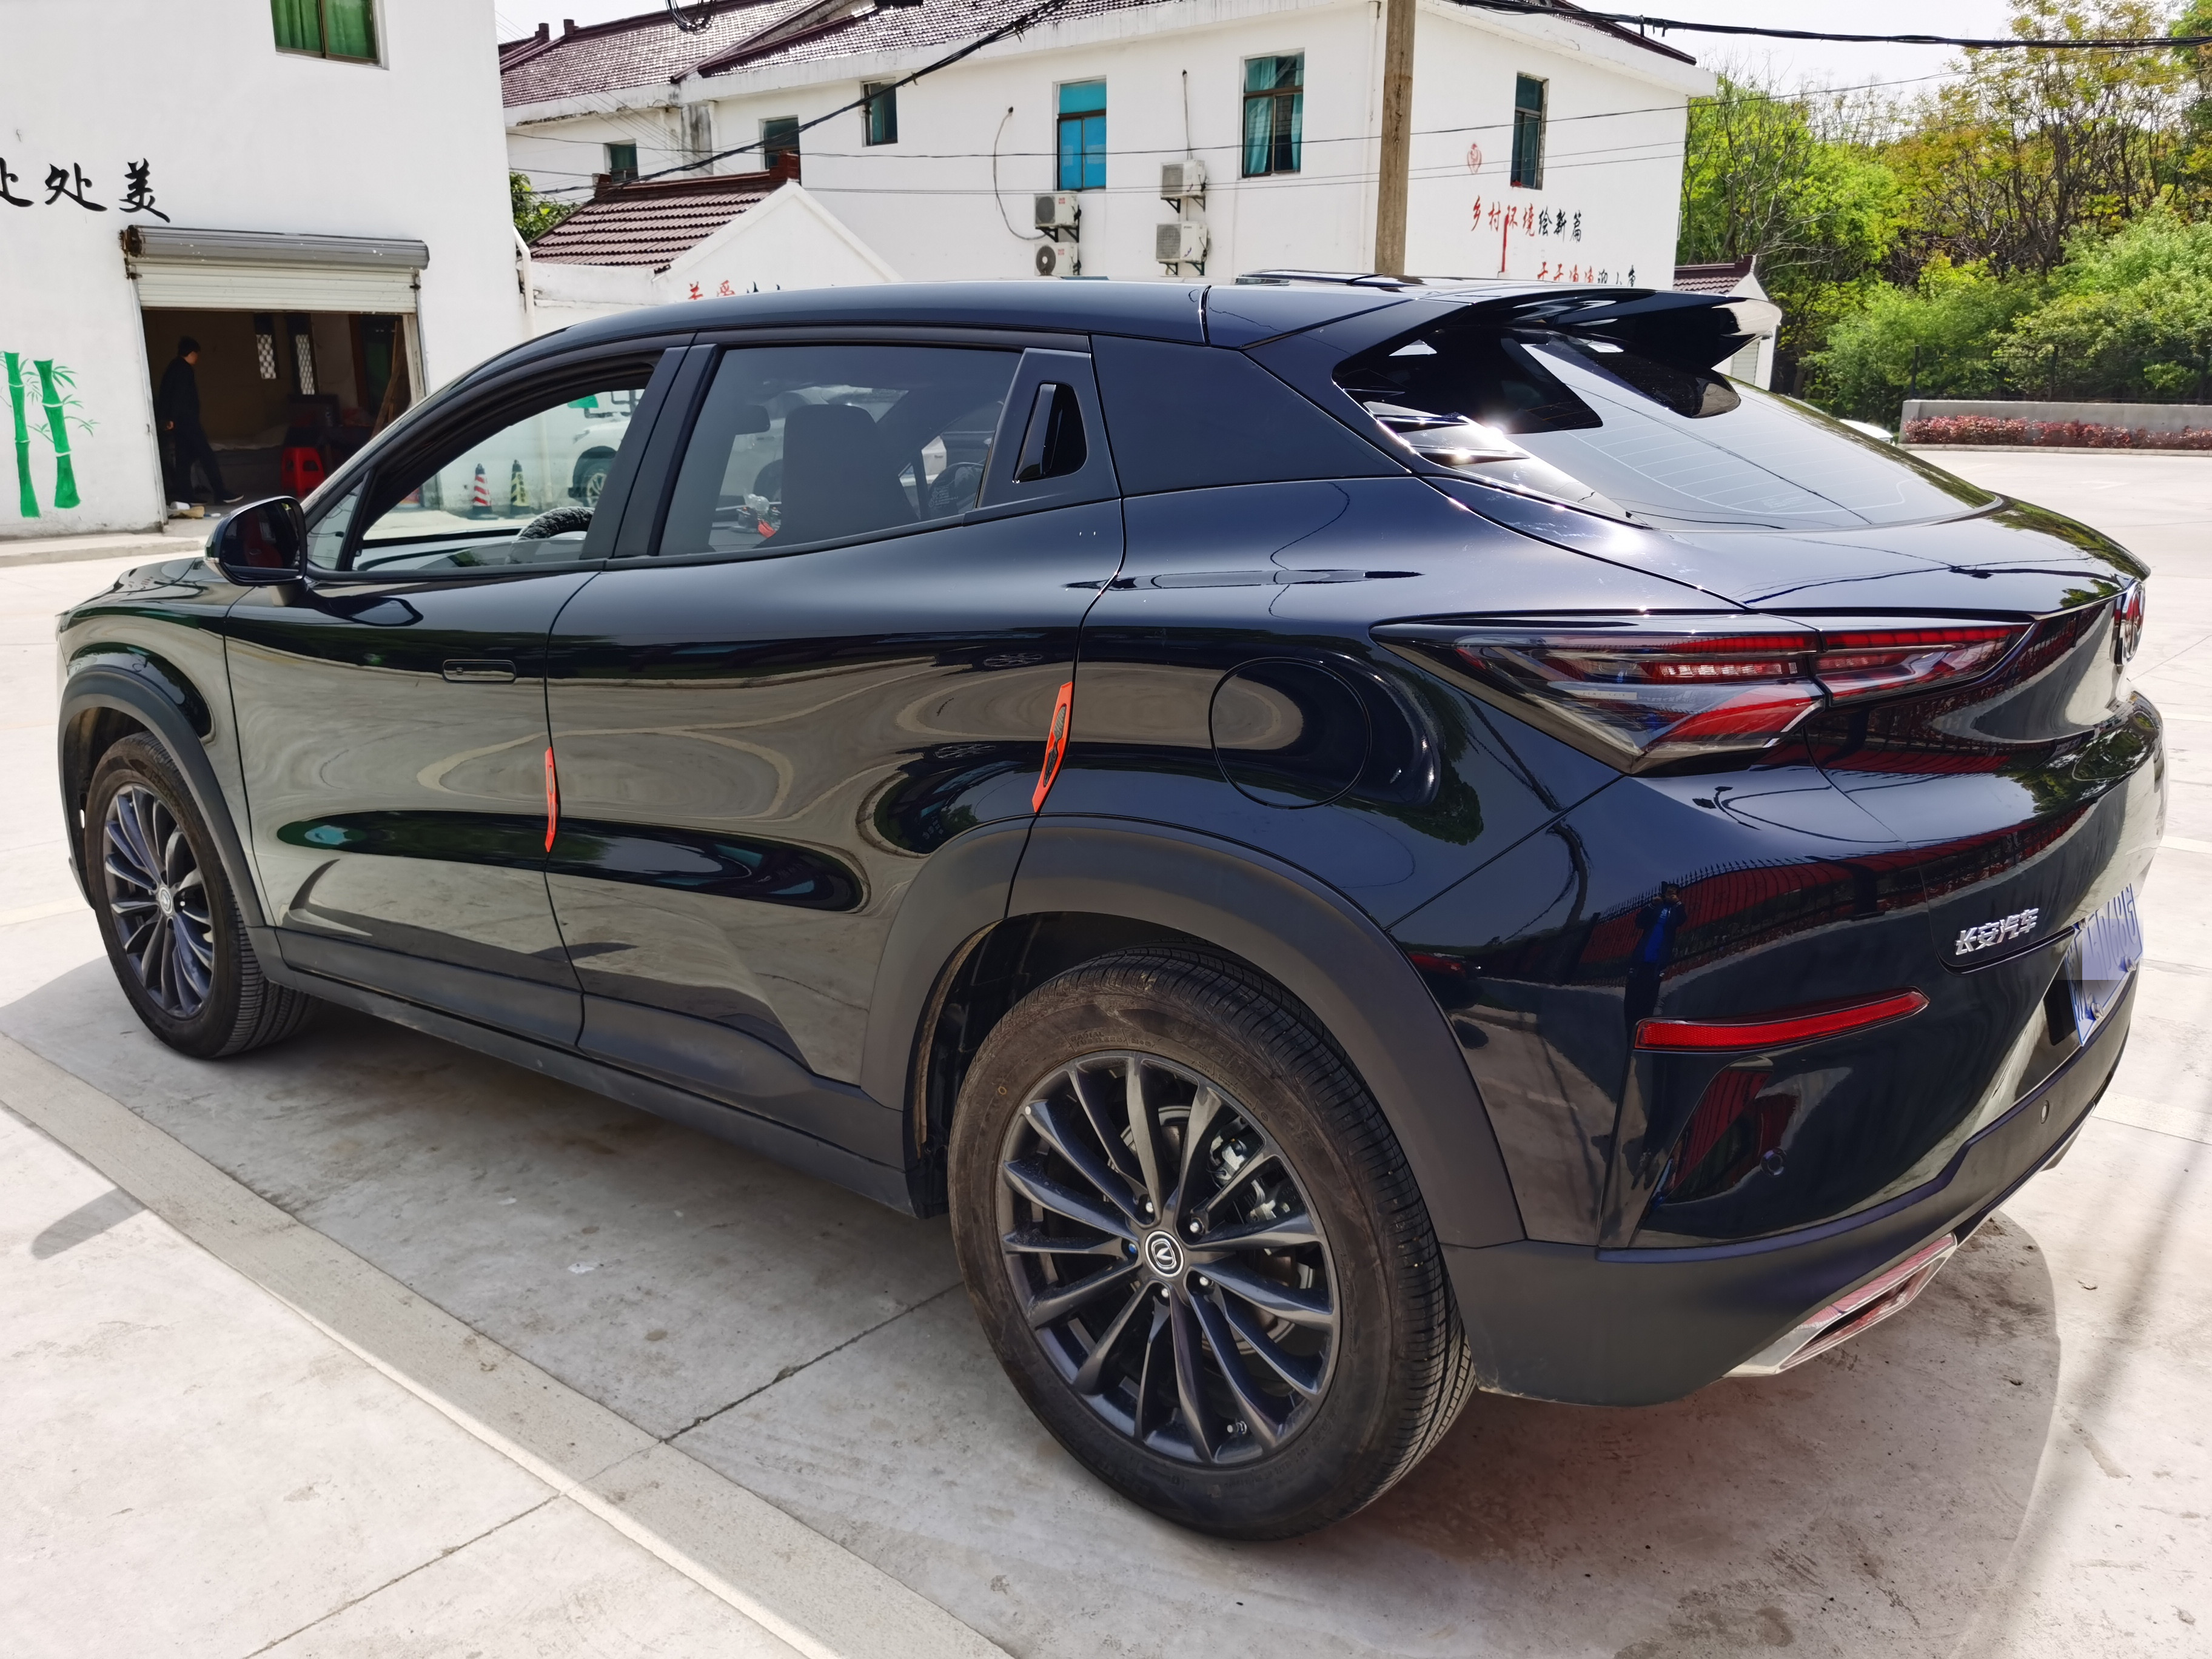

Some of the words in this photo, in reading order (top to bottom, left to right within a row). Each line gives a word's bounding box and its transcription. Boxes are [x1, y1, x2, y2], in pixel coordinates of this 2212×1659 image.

[1471, 195, 1581, 243] 乡村环境绘新篇
[1955, 908, 2039, 956] 长安汽车
